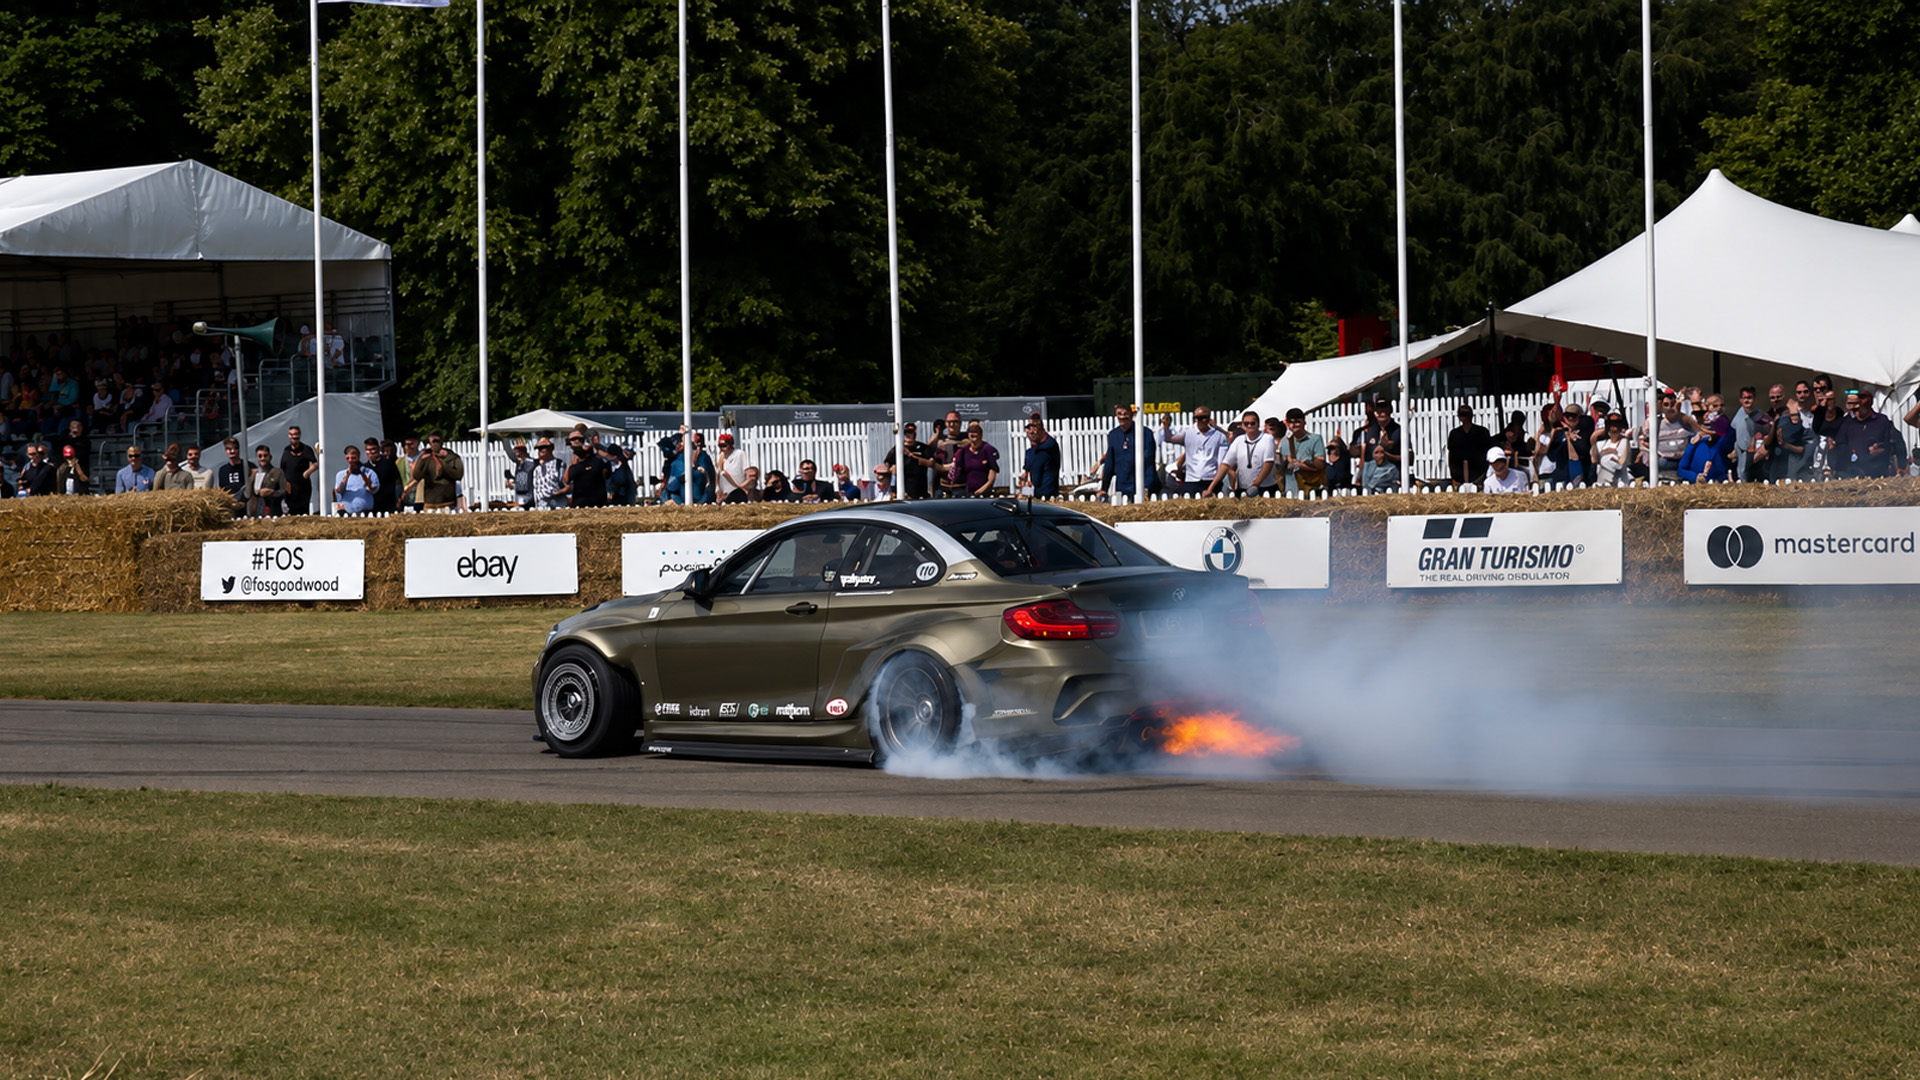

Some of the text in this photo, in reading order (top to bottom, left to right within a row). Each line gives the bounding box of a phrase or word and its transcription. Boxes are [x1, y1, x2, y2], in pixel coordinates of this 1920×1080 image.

[1774, 531, 1915, 554] mastercard
[251, 546, 305, 571] #FOS
[456, 548, 519, 584] ebay
[1418, 546, 1475, 571] GRAN
[919, 565, 935, 577] 110
[1419, 574, 1438, 582] THE
[1440, 573, 1464, 582] REAL
[1466, 572, 1505, 582] DRIVING
[240, 575, 339, 596] @fosgoodwood
